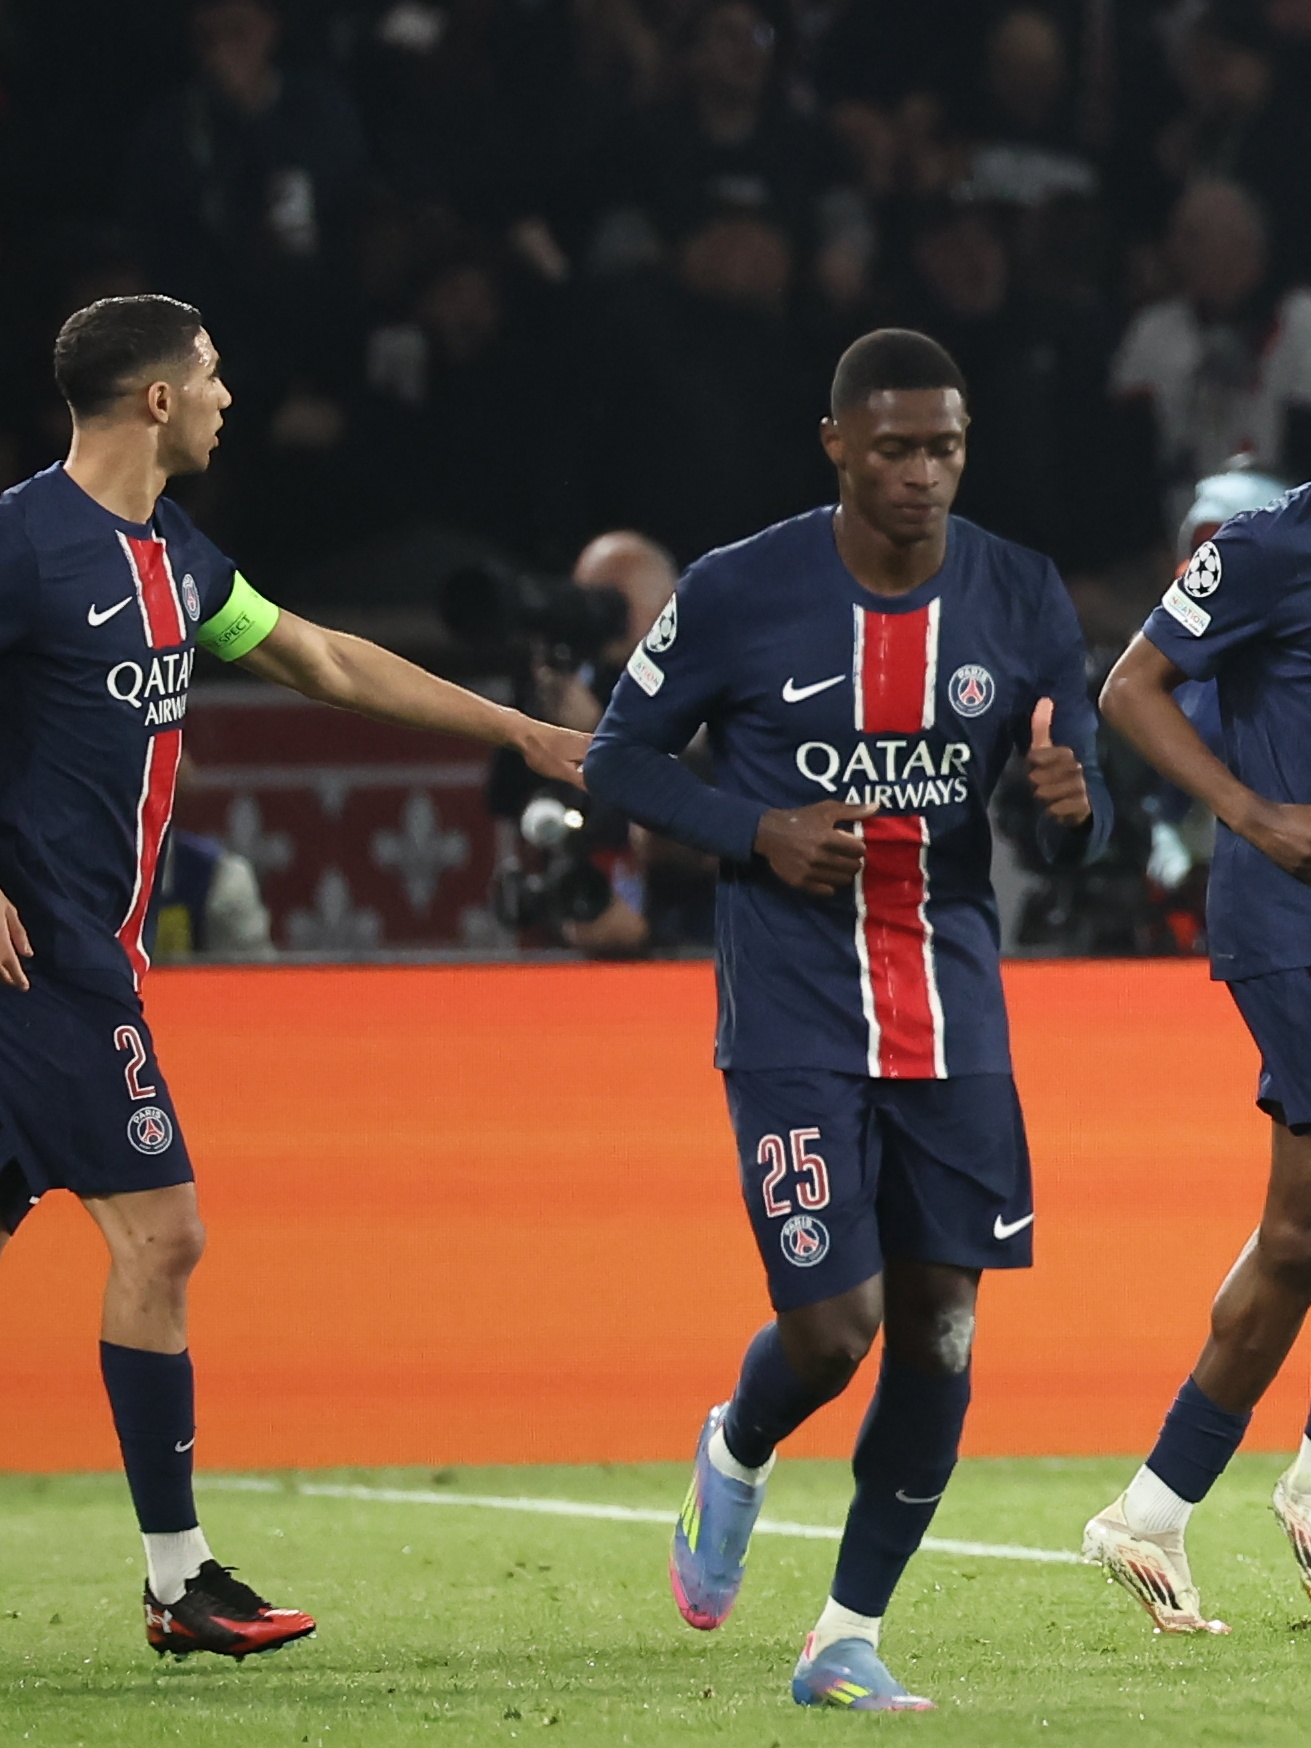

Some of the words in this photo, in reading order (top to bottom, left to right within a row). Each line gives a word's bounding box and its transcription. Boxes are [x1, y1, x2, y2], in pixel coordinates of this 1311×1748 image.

[796, 740, 971, 792] QATAR
[845, 776, 968, 809] AIRWAYS
[114, 1025, 157, 1100] 2
[133, 1108, 162, 1125] PARIS
[757, 1127, 830, 1217] 25
